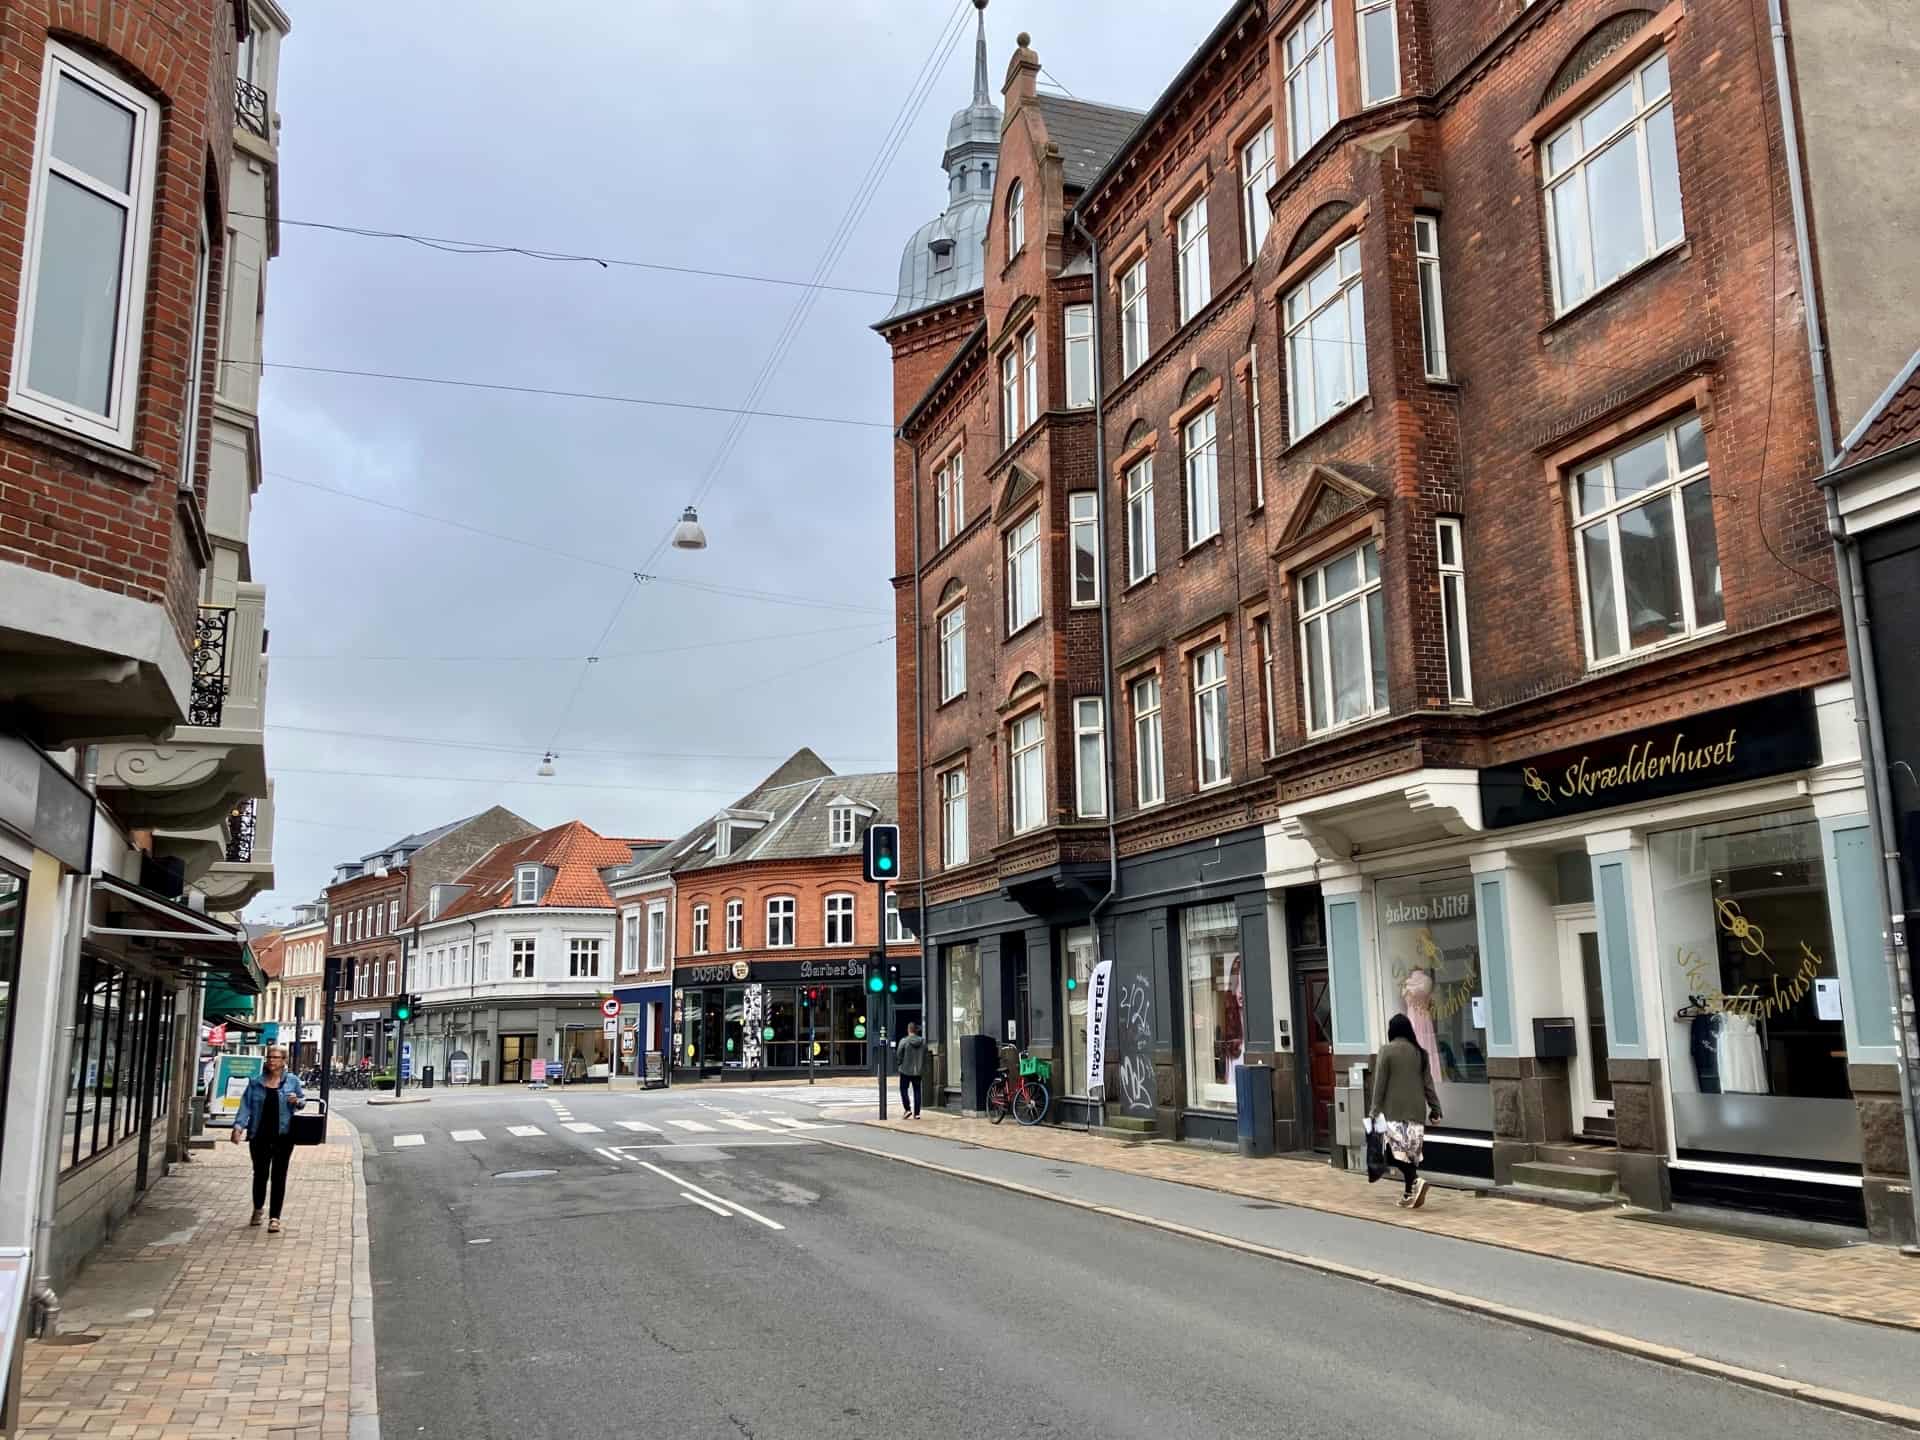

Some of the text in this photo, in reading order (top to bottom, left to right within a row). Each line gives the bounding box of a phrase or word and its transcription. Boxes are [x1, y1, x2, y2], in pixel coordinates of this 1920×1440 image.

[1559, 729, 1737, 797] Skrædderhuset
[801, 959, 864, 978] Barber Sh
